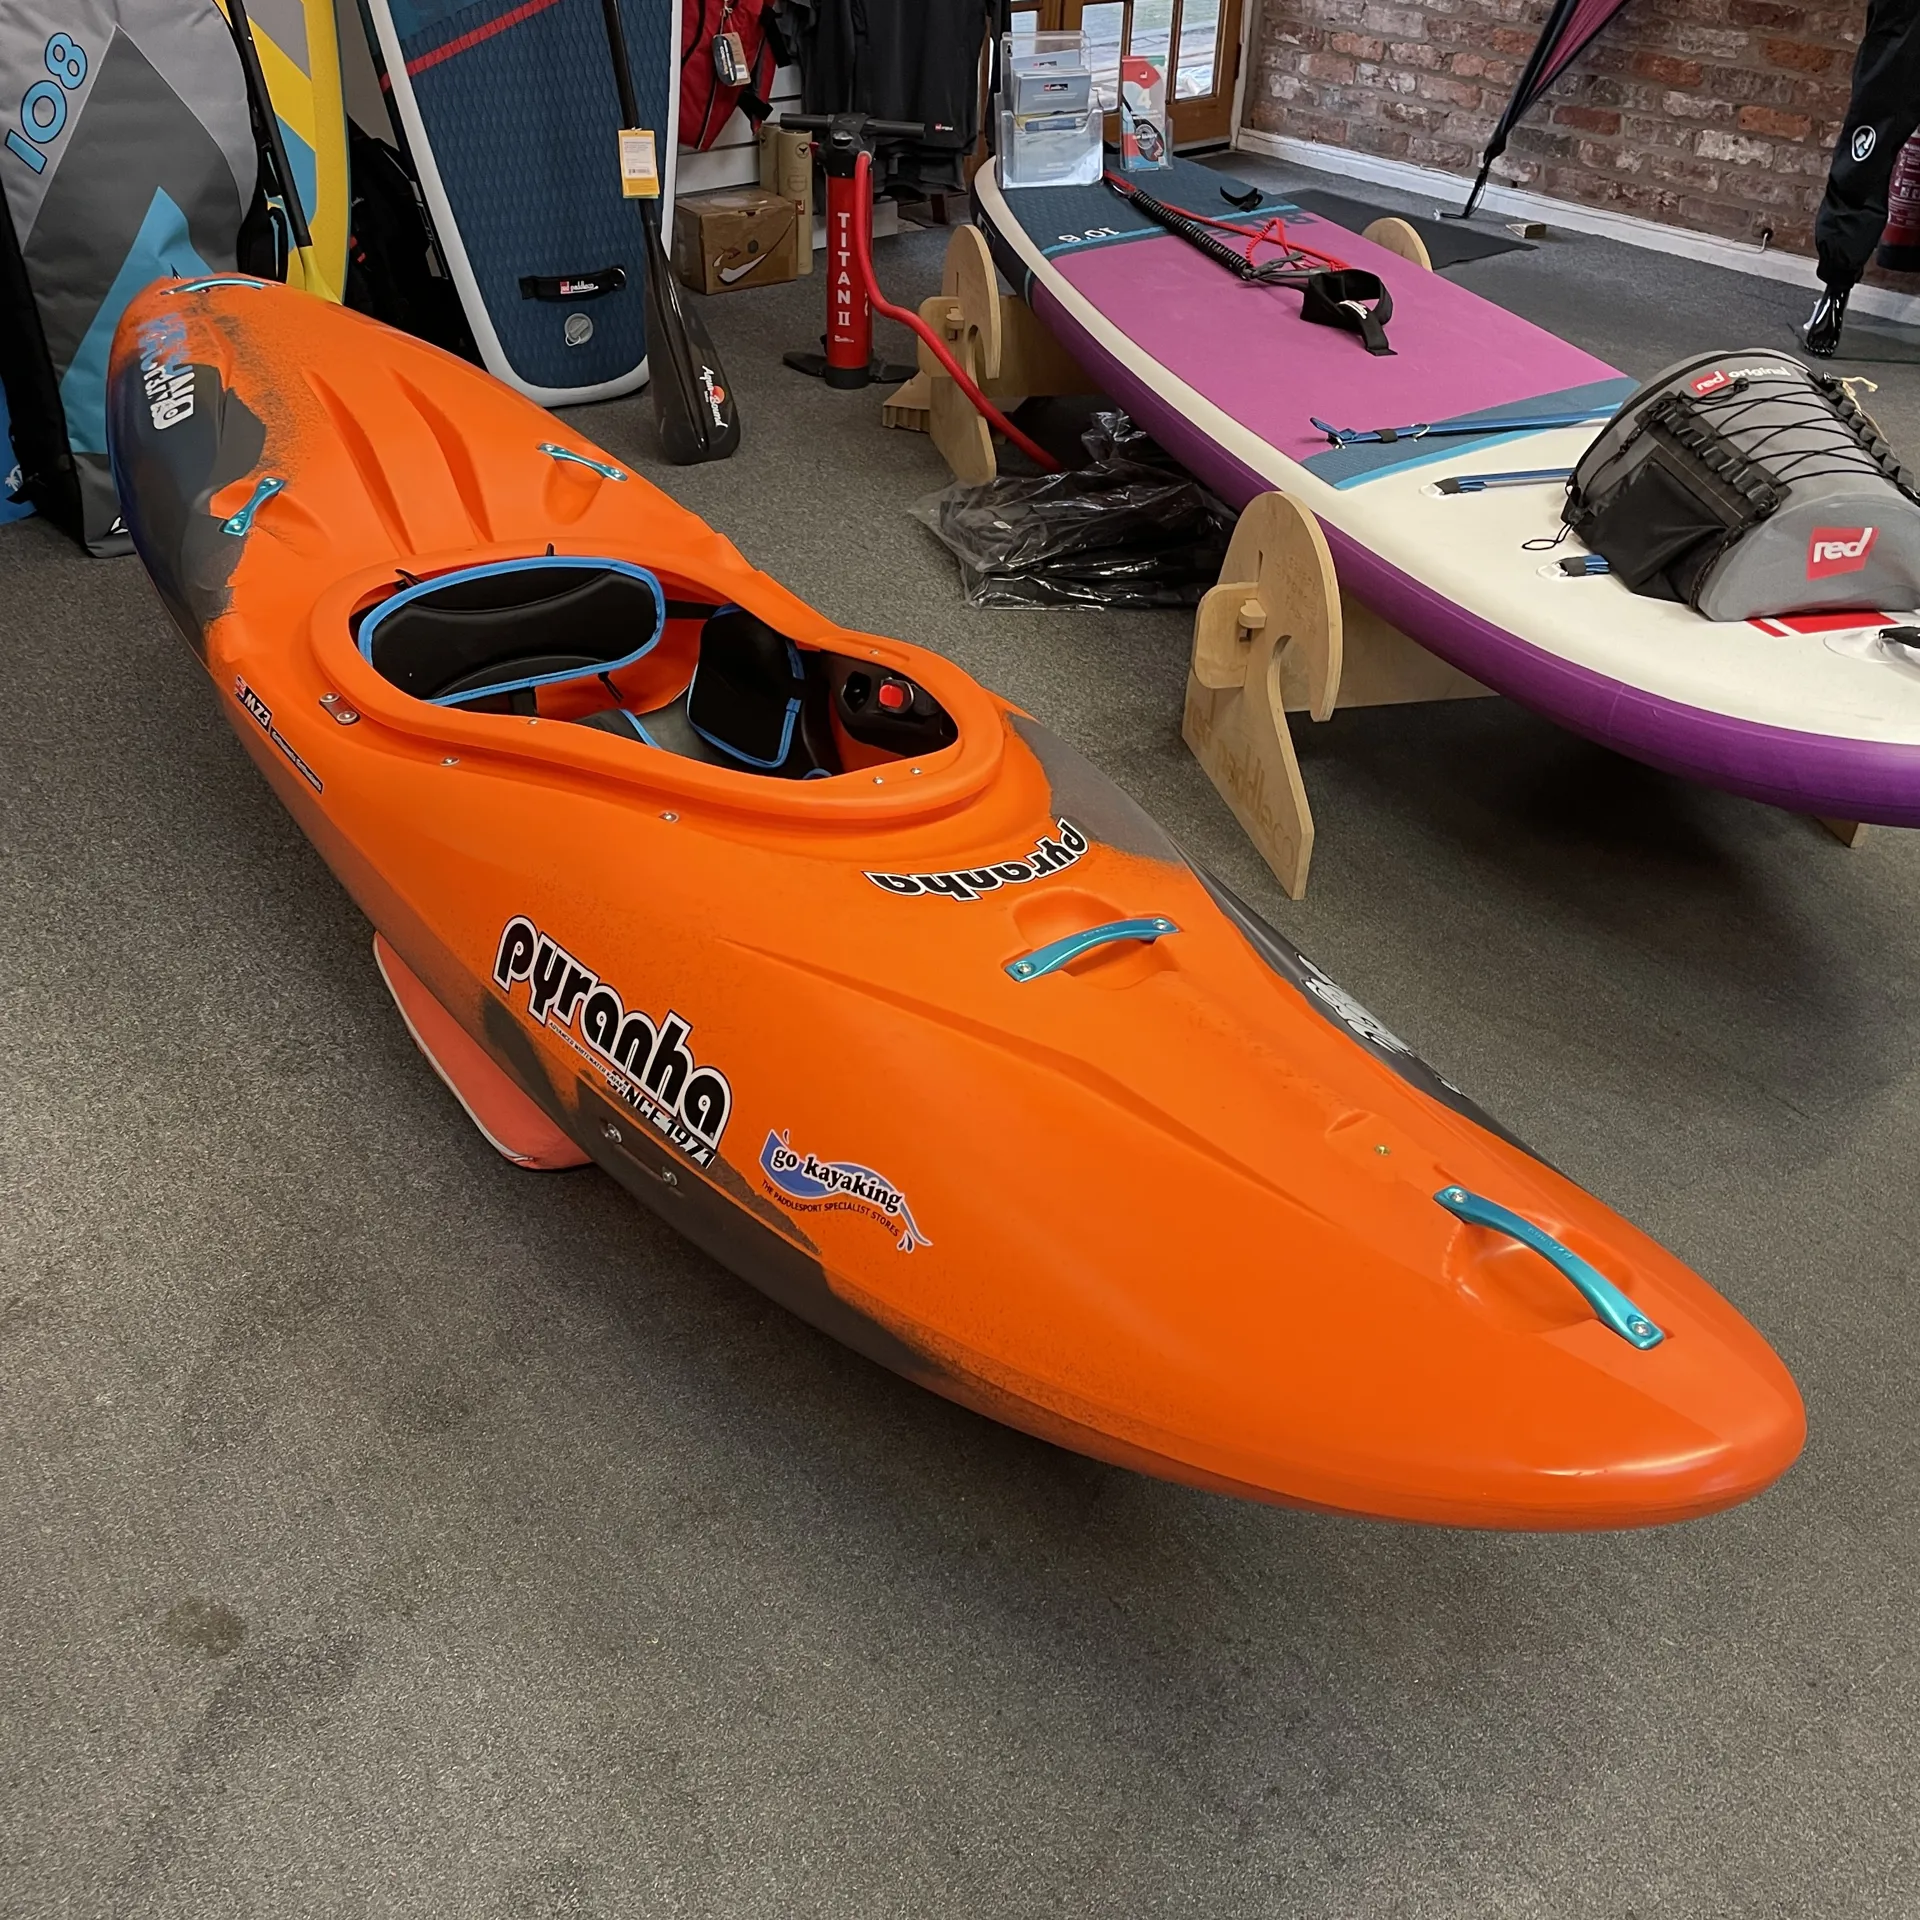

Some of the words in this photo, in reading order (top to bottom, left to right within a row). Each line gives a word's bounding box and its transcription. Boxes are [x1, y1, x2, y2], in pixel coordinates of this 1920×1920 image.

[4, 31, 88, 175] 108
[837, 211, 851, 305] TITAN
[1695, 370, 1726, 391] red
[1728, 366, 1792, 378] original
[1812, 527, 1873, 563] red
[243, 692, 271, 727] MZ3
[860, 816, 1090, 902] pyranha
[493, 915, 732, 1151] pyranha
[607, 1070, 667, 1121] SINCE
[664, 1117, 716, 1169] 1971
[761, 1178, 774, 1195] THE
[774, 1191, 822, 1213] PADDLESPORT
[823, 1202, 871, 1216] SPECIALIST
[870, 1211, 901, 1238] STORES
[772, 1149, 798, 1169] go
[803, 1156, 903, 1214] kayaking
